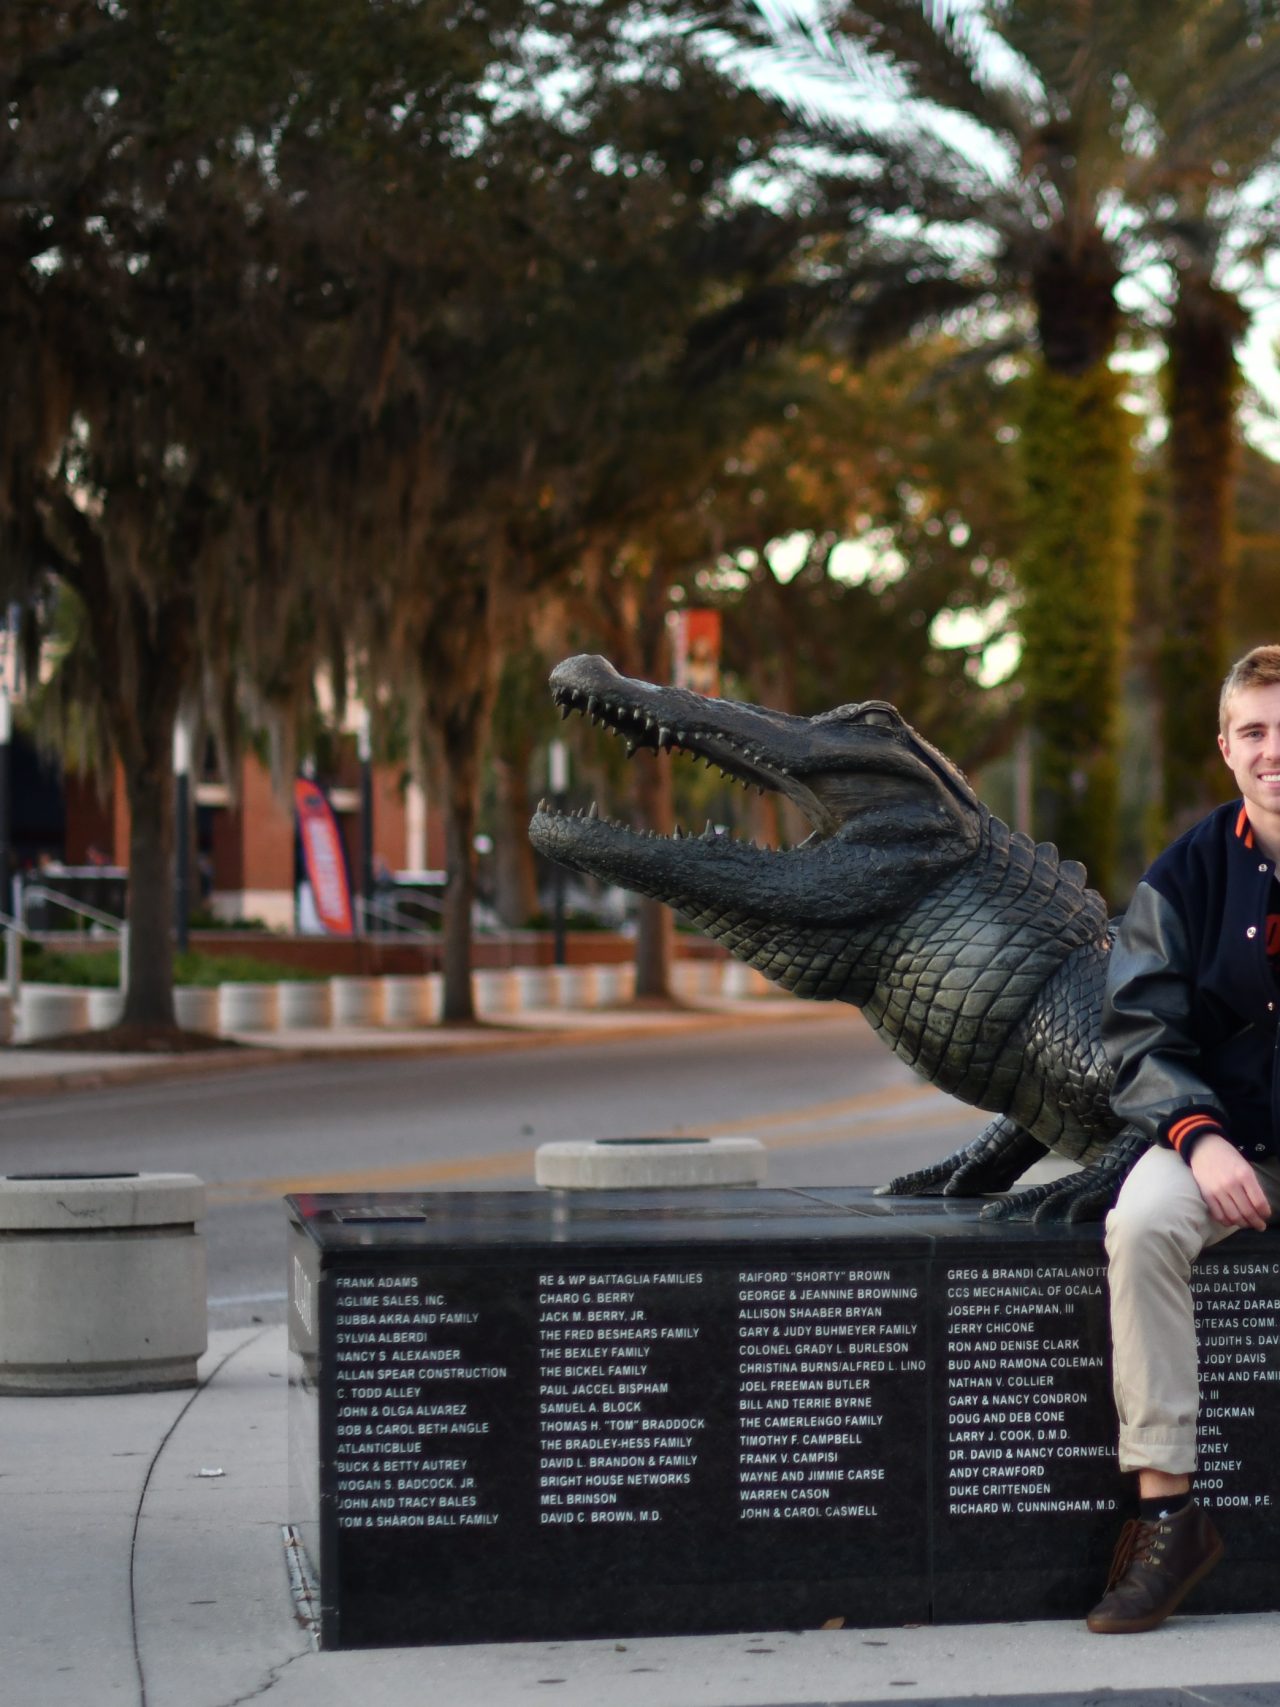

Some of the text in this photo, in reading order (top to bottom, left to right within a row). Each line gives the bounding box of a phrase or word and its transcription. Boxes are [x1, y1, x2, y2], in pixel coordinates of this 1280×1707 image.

[336, 1275, 419, 1288] FRANK ADAMS
[539, 1271, 703, 1286] RE & WP BATTAGLIA FAMILIES
[739, 1268, 891, 1284] RAIFORD "SHORTY" BROWN
[739, 1286, 918, 1302] GEORGE & JEANNINE BROWNING
[1207, 1299, 1241, 1311] TARAZ
[337, 1311, 479, 1326] BUBBA AKRA AND FAMILY
[739, 1305, 882, 1320] ALLISON SHAABER BRYAN
[540, 1326, 700, 1341] THE FRED BESHEARS FAMILY
[739, 1323, 917, 1337] GARY & JUDY BUHMEYER FAMILY
[948, 1321, 1035, 1334] JERRY CHICONE
[337, 1331, 428, 1344] SYLVIA ALBERDI
[541, 1345, 650, 1359] THE BEXLEY FAMILY
[948, 1338, 1080, 1352] RON AND DENISE CLARK
[337, 1366, 507, 1380] ALLAN SPEAR CONSTRUCTION
[541, 1364, 647, 1377] THE BICKEL FAMILY
[1228, 1370, 1251, 1382] AND
[540, 1382, 669, 1396] PAUL JACCEL BISPHAM
[740, 1378, 870, 1392] JOEL FREEMAN BUTLER
[949, 1392, 1088, 1406] GARY & NANCY CONDRON
[949, 1409, 1065, 1425] DOUG AND DEB CONE
[1206, 1405, 1255, 1418] DICKMAN
[337, 1421, 489, 1436] BOB & CAROL BETH ANGLE
[740, 1414, 883, 1429] THE CAMERLENGO FAMILY
[338, 1440, 422, 1455] ATLANTICBLUE
[541, 1436, 693, 1450] THE BRADLEY-HESS FAMILY
[740, 1468, 885, 1483] WAYNE AND JIMMIE CARSE
[950, 1464, 1045, 1479] ANDY CRAWFORD
[540, 1472, 691, 1487] BRIGHT HOUSE NETWORKS
[740, 1487, 830, 1500] WARREN CASON
[950, 1482, 1051, 1497] DUKE CRITTENDEN
[541, 1491, 617, 1505] MEL BRINSON
[339, 1512, 499, 1528] TOM & SHARON BALL FAMILY
